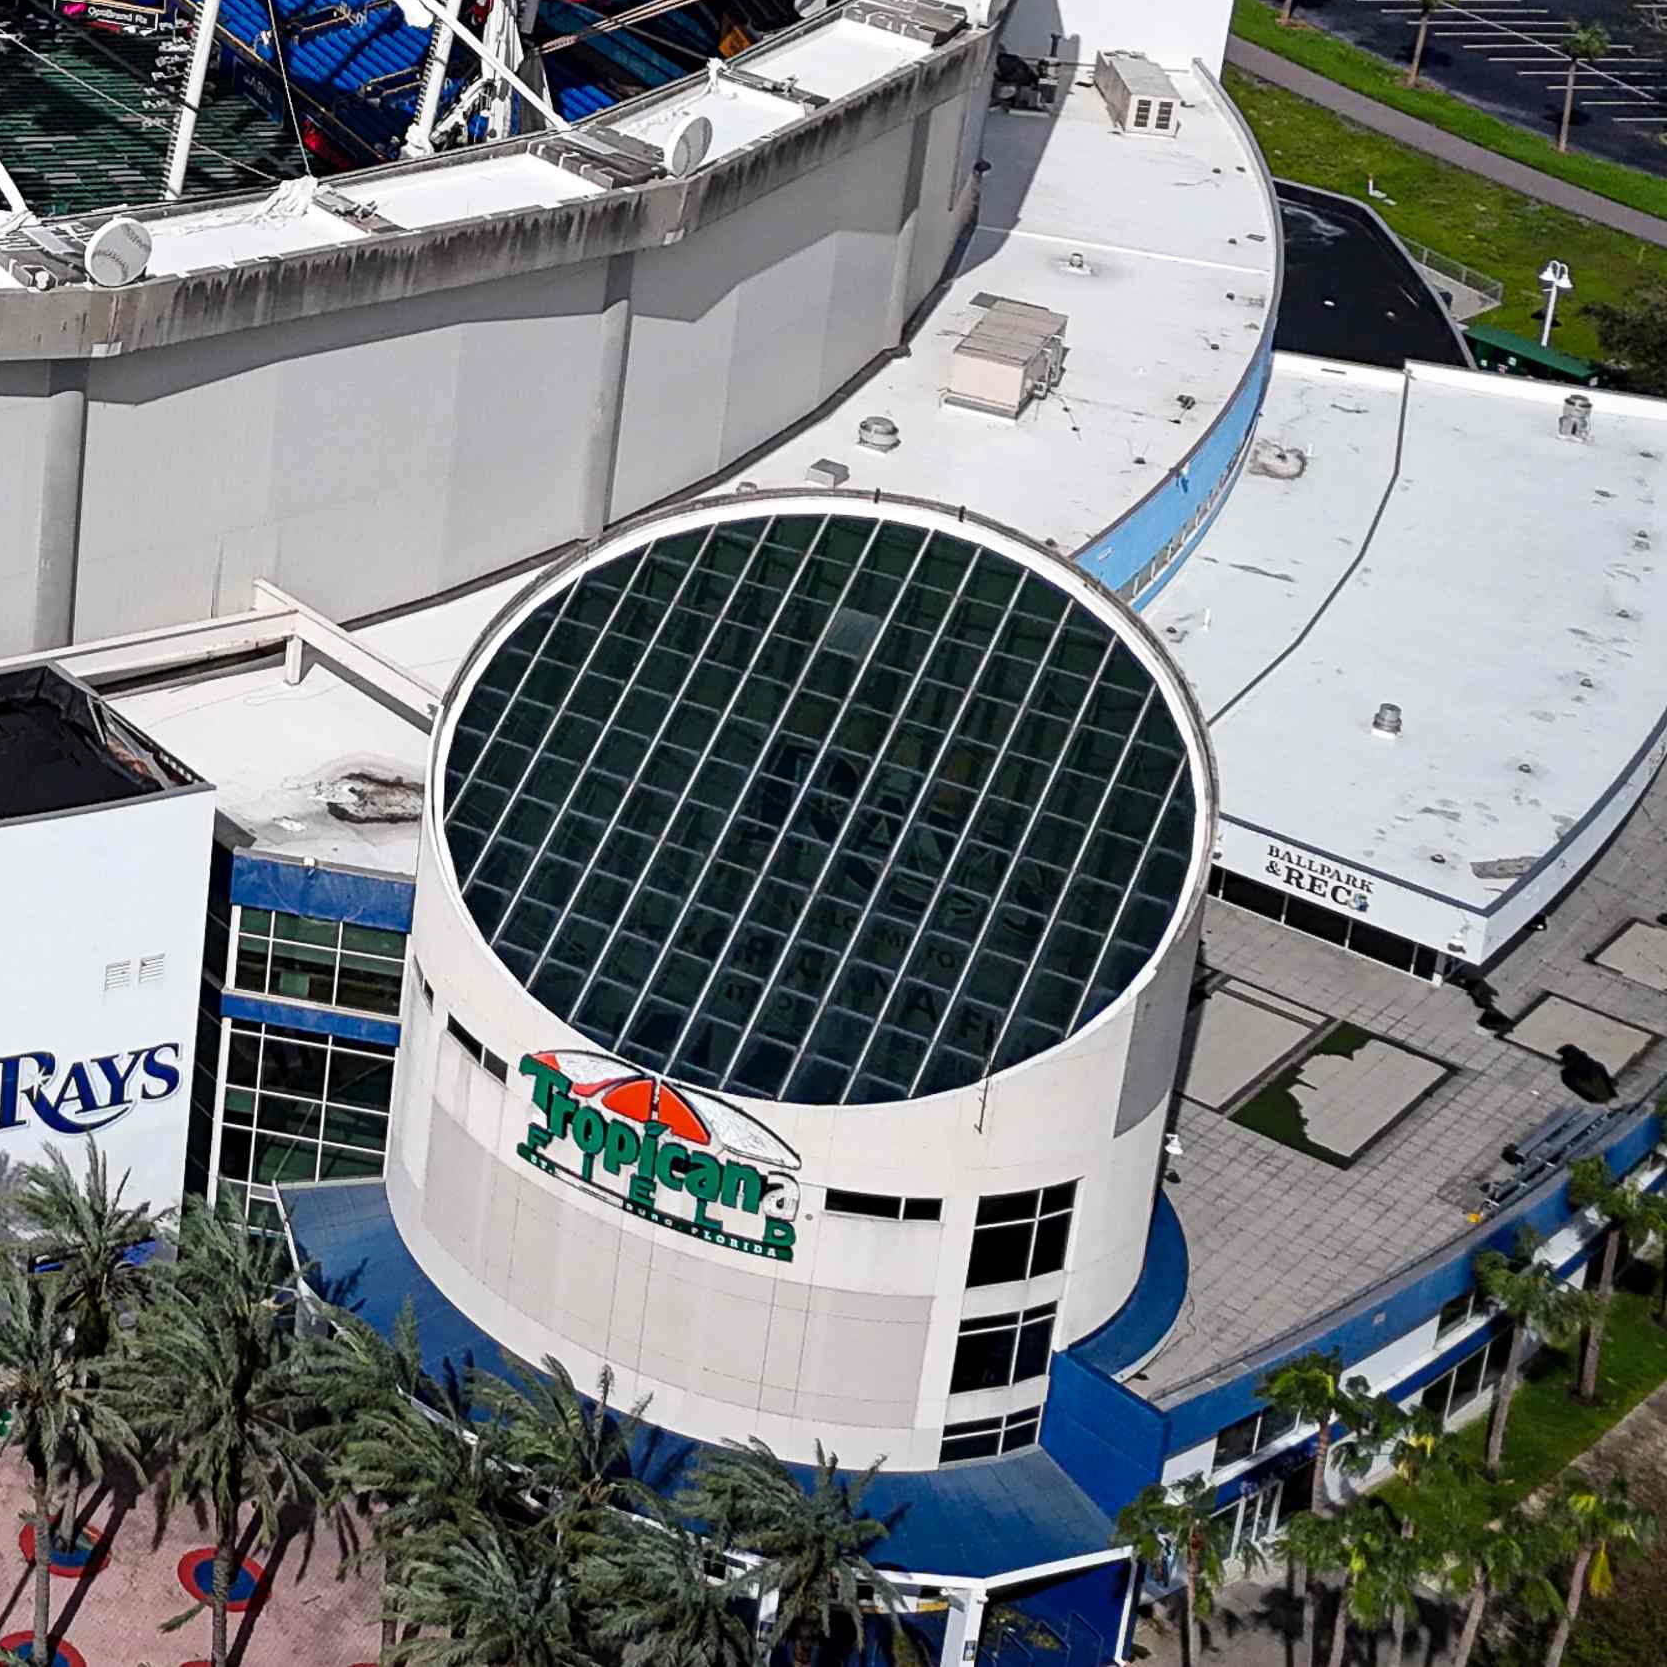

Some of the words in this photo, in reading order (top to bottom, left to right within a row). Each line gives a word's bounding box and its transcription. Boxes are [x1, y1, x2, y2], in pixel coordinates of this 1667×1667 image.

[1267, 844, 1374, 894] BALLPARK
[519, 1052, 801, 1222] Tropicana
[527, 1122, 797, 1248] FIELD
[690, 1227, 779, 1260] FLORIDA
